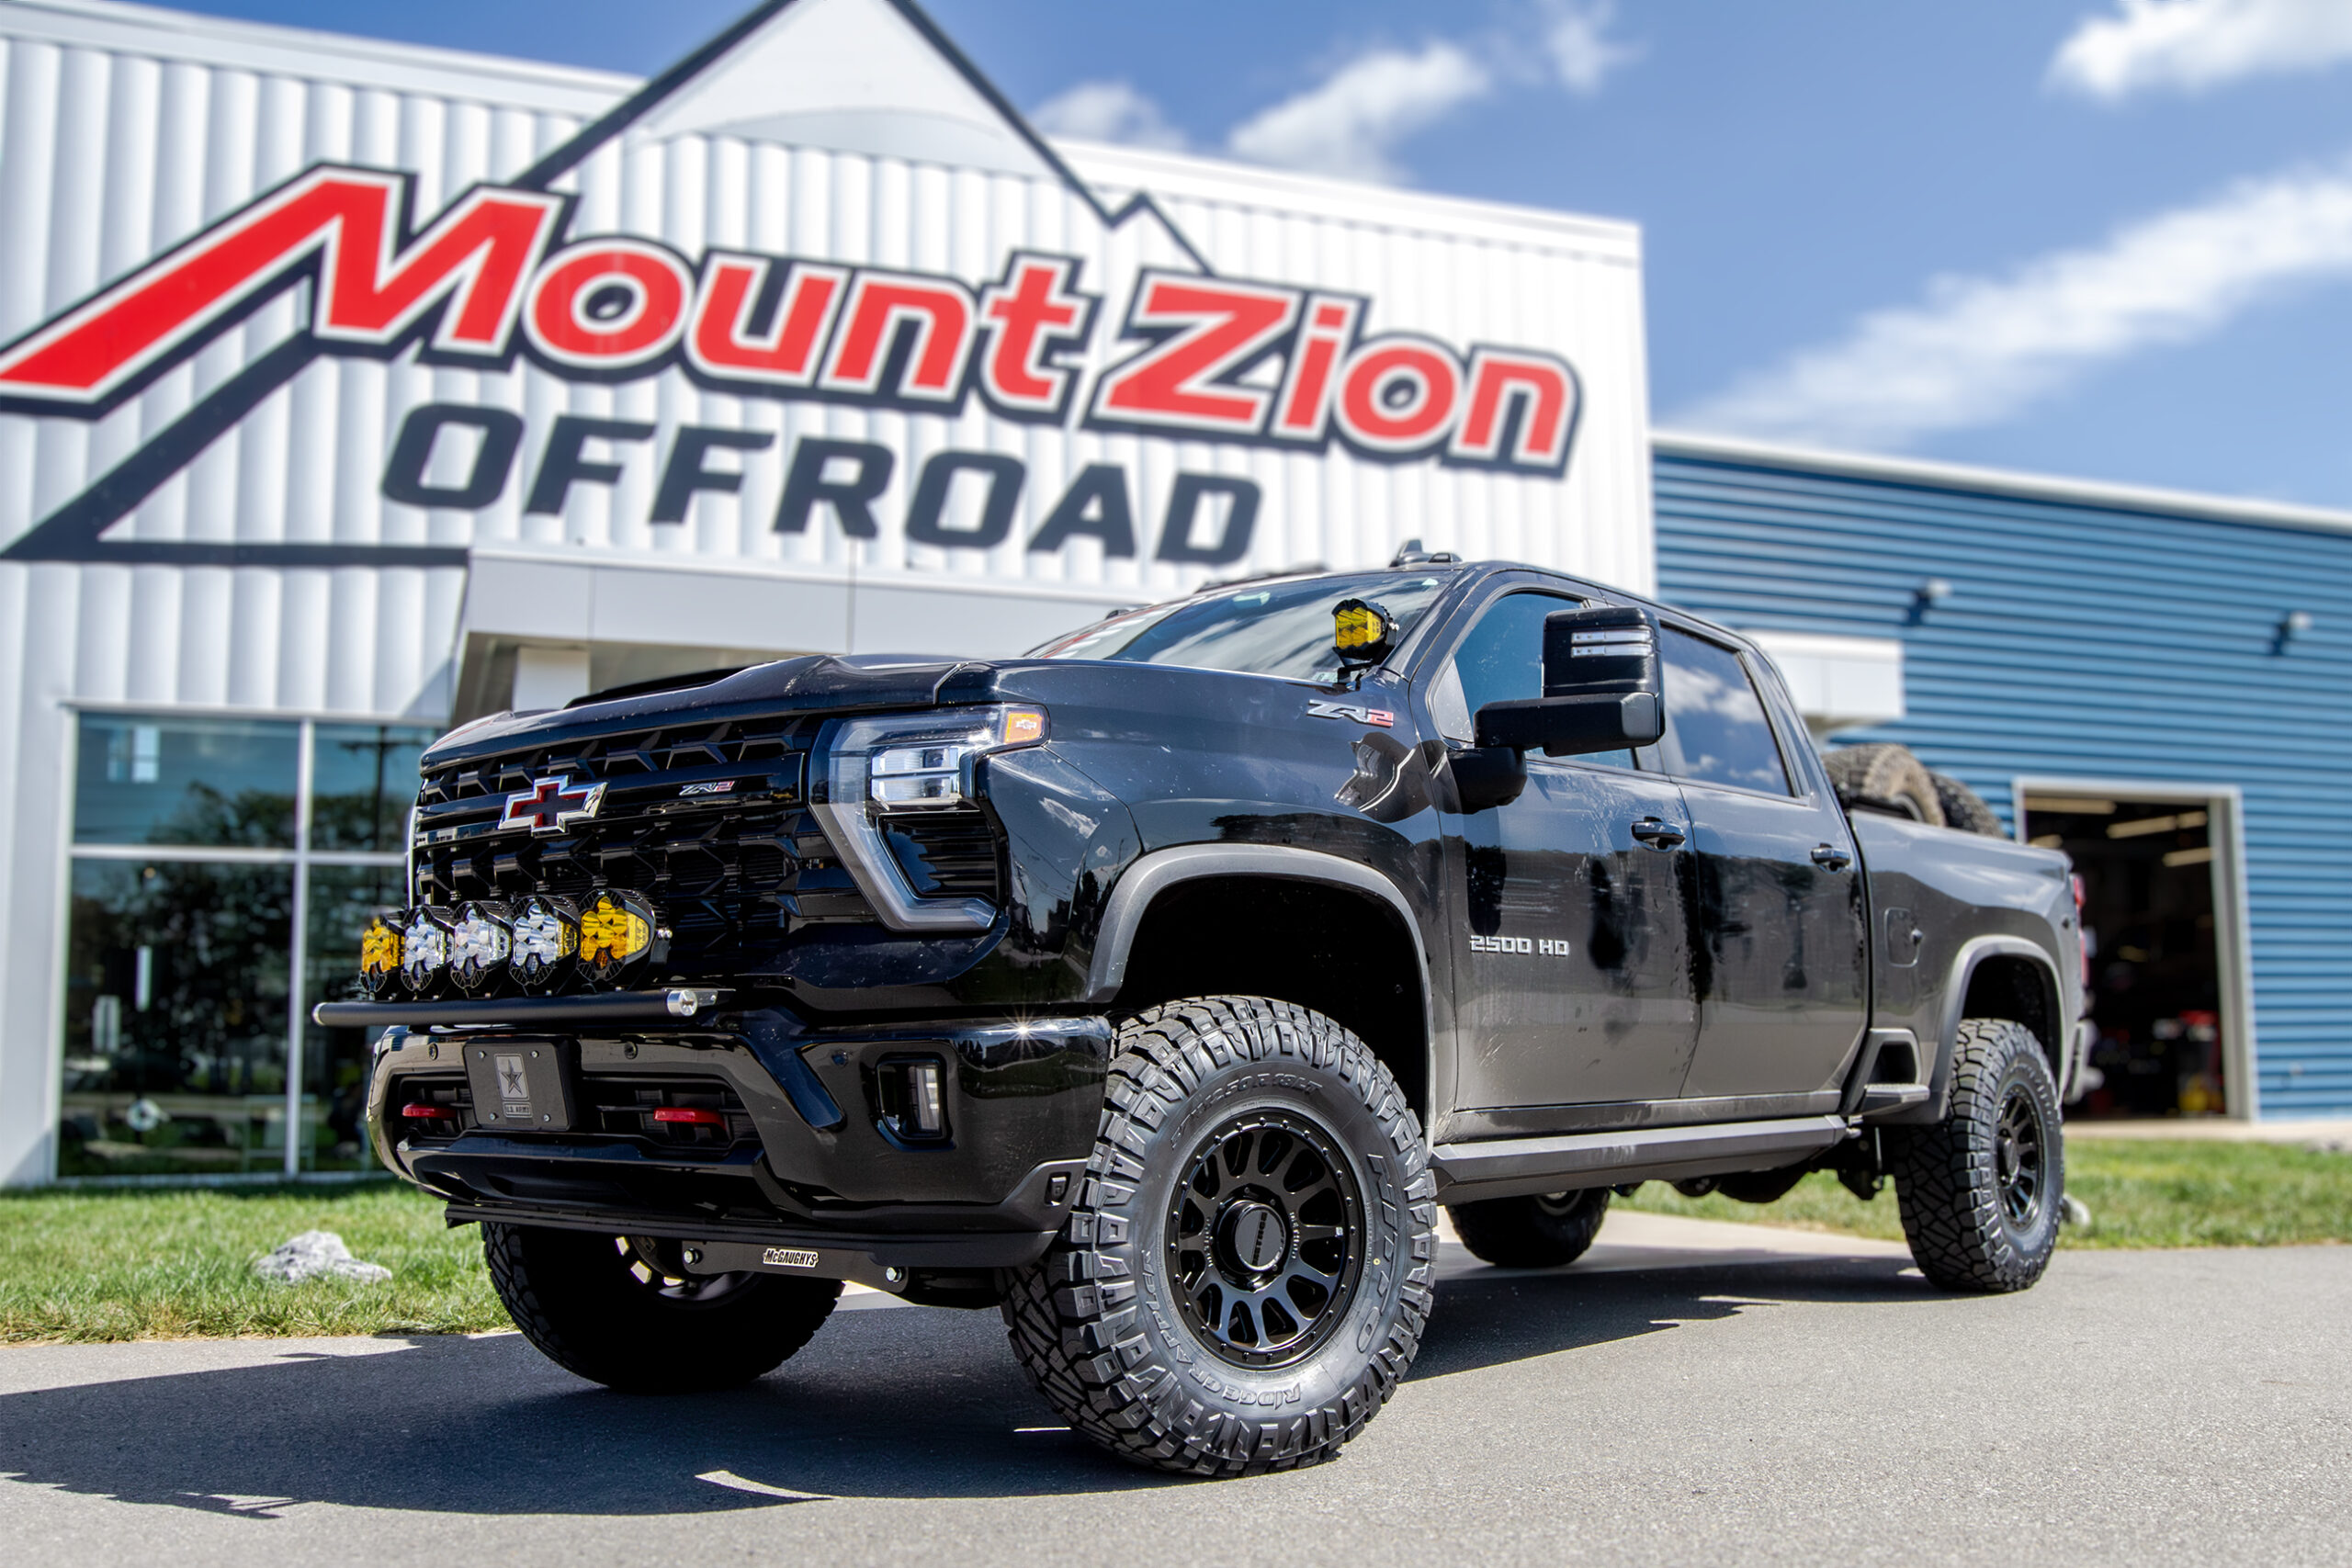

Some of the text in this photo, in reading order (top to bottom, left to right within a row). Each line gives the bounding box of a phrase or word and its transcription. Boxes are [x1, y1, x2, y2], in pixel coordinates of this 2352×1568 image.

[0, 165, 1577, 468] Mount Zion
[381, 401, 1262, 565] OFFROAD
[1307, 698, 1394, 728] ZR2
[679, 781, 735, 795] ZR2
[1470, 935, 1569, 956] 2500 HD
[1356, 1154, 1398, 1354] NITTO
[1222, 1382, 1301, 1411] RIDGE
